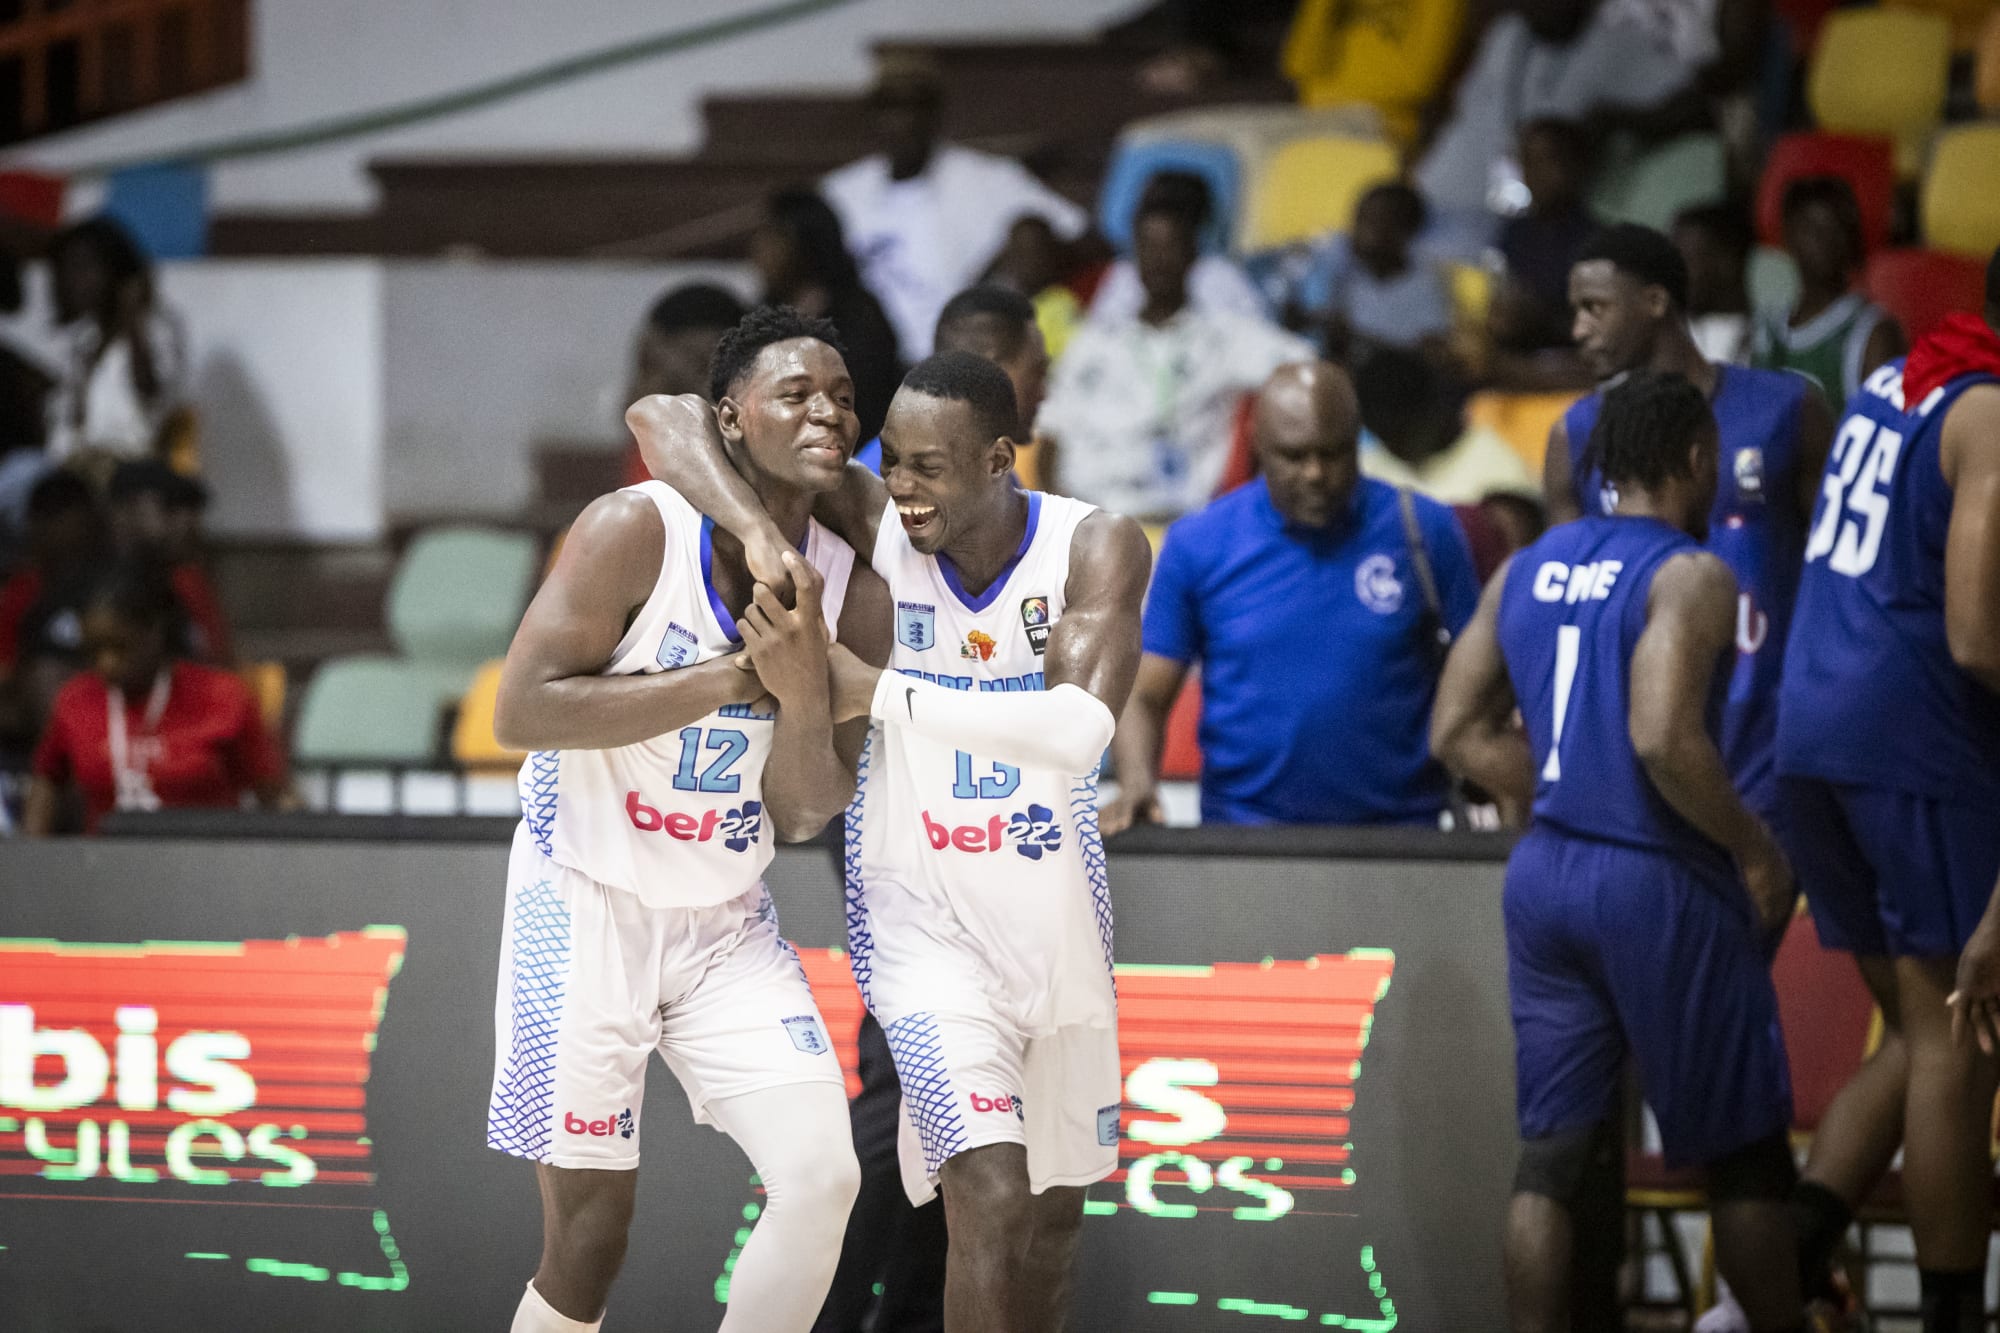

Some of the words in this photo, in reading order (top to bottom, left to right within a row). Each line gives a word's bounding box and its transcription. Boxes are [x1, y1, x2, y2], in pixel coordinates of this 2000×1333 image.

[1805, 413, 1903, 578] 35
[1541, 623, 1581, 782] 1
[672, 726, 749, 793] 12
[953, 749, 1021, 799] 13
